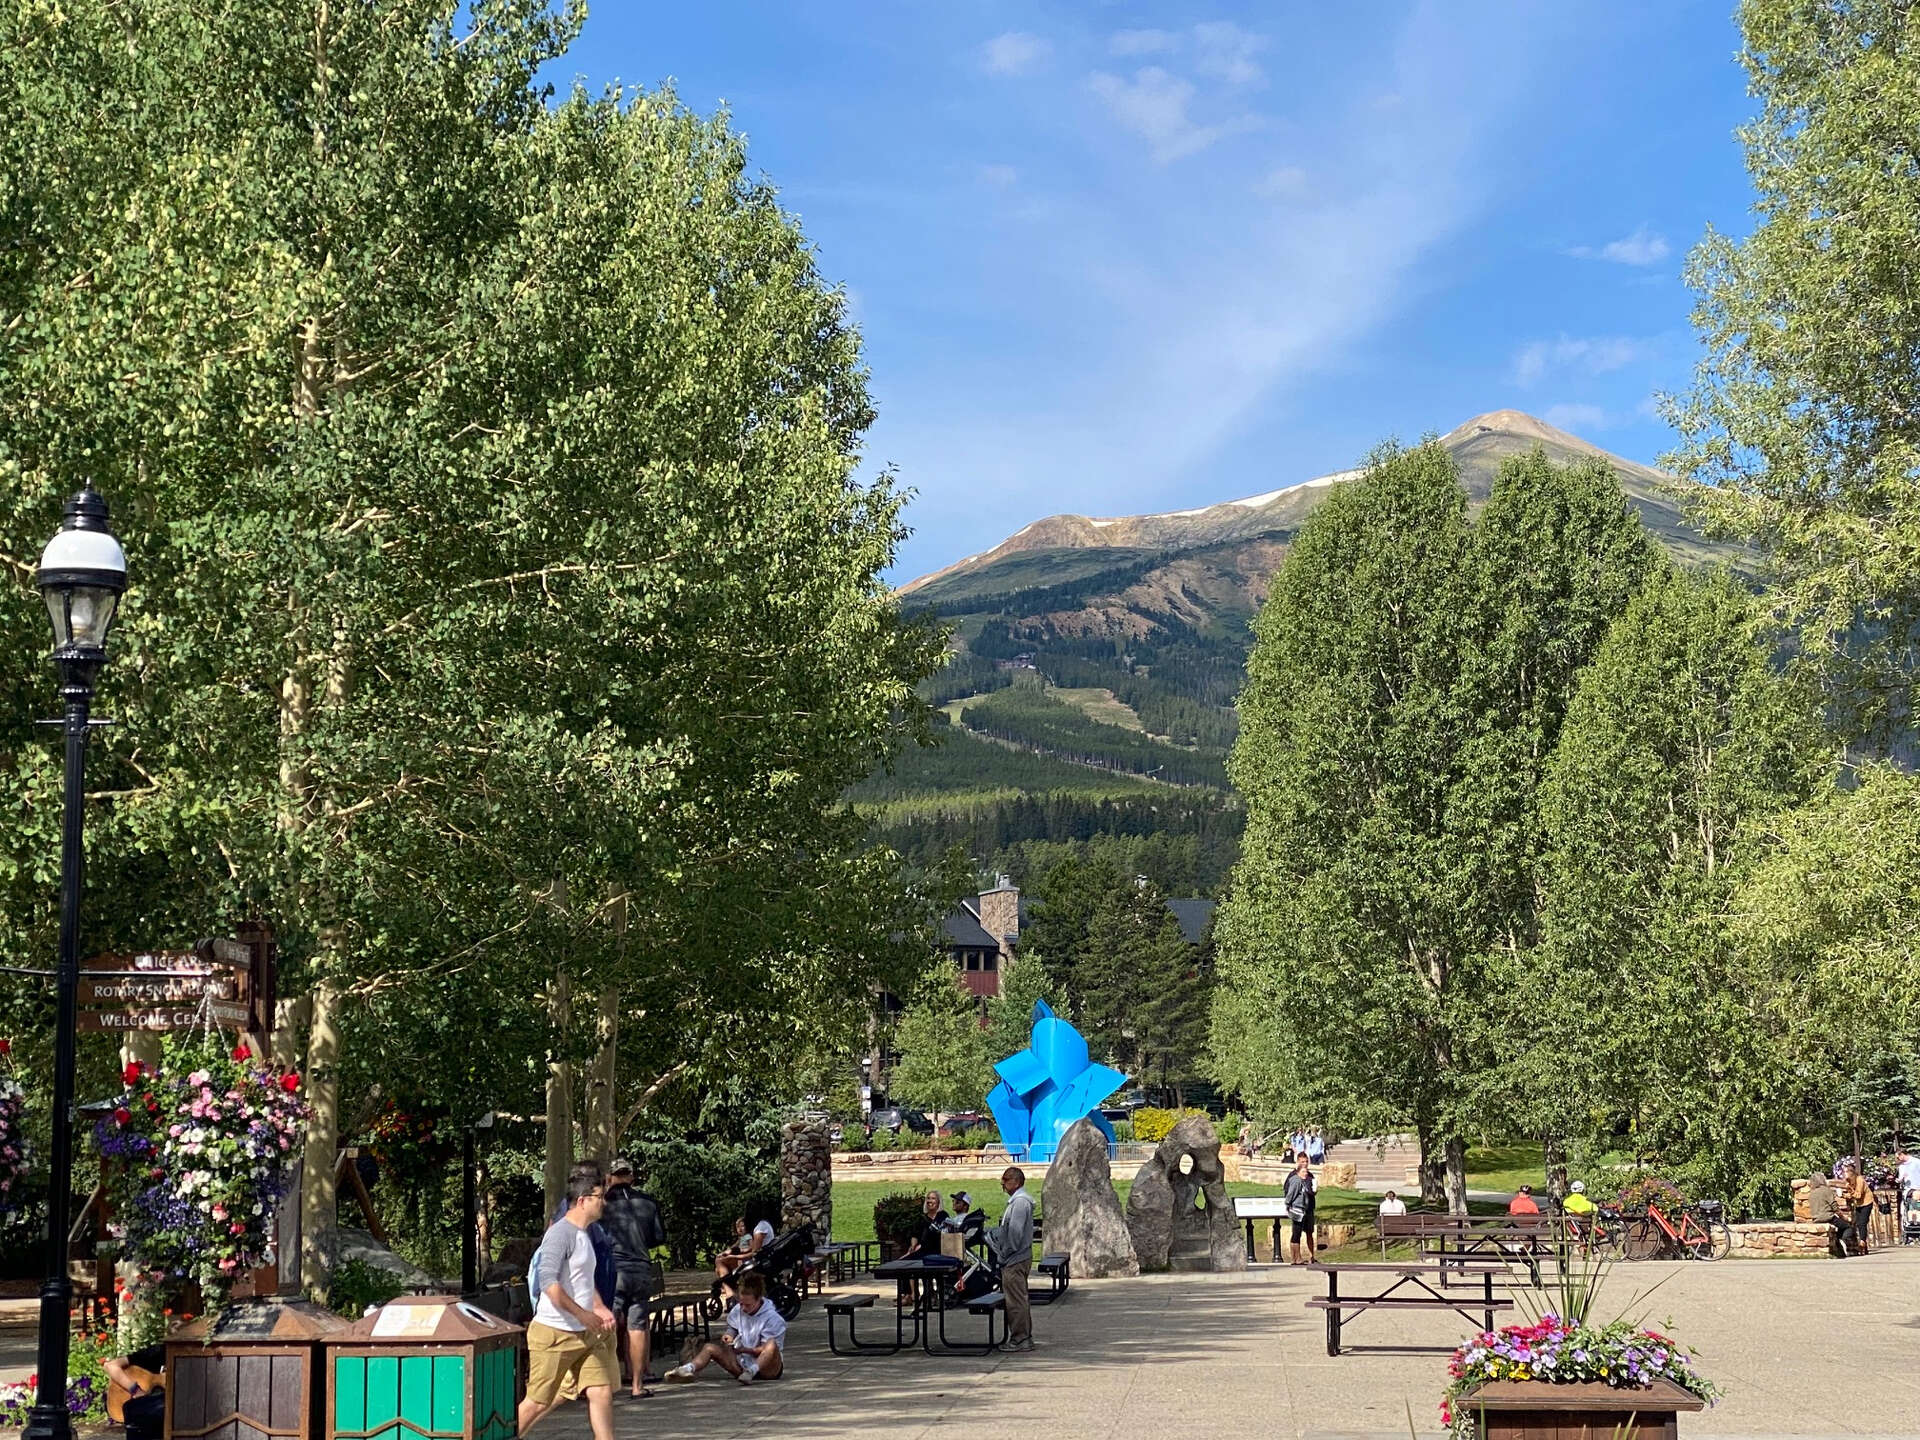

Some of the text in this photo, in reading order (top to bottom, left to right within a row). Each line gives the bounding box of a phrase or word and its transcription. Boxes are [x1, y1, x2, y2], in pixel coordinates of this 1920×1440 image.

[154, 956, 174, 968] ICE
[94, 985, 144, 998] ROTARY
[146, 984, 182, 996] SNOW
[100, 1014, 168, 1026] WELCOME
